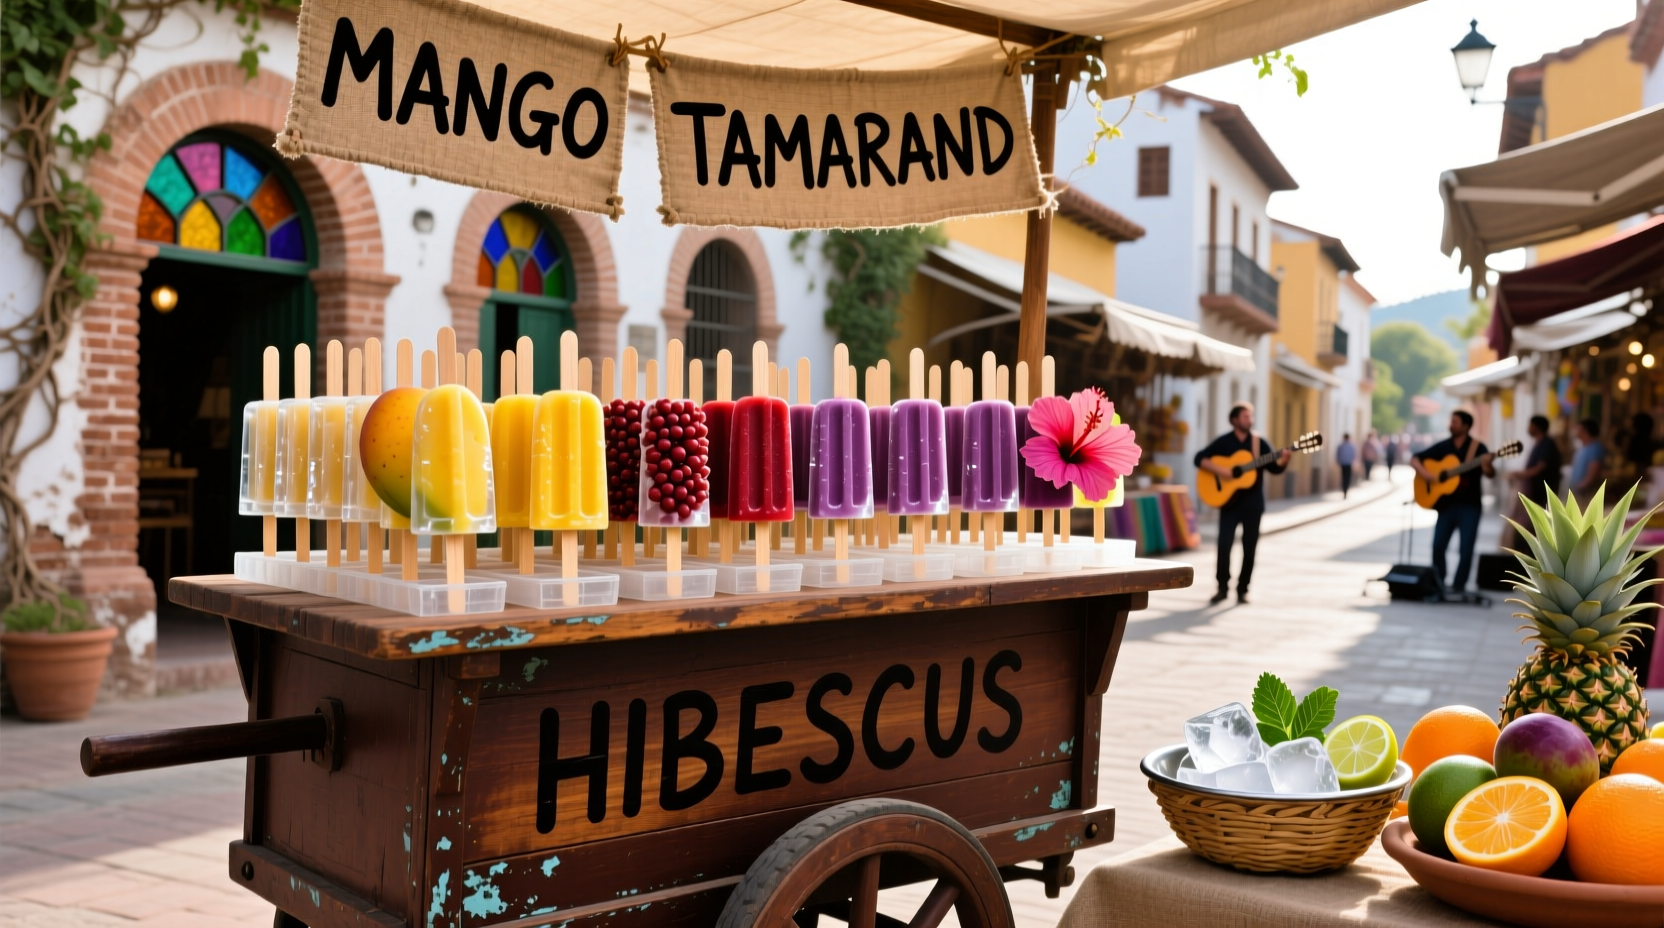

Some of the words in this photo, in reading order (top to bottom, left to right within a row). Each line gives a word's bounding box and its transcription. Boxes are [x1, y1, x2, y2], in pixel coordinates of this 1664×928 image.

[320, 16, 610, 160] MANGO
[671, 102, 1014, 190] TAMARAND
[537, 649, 1023, 834] HIBESCUS
